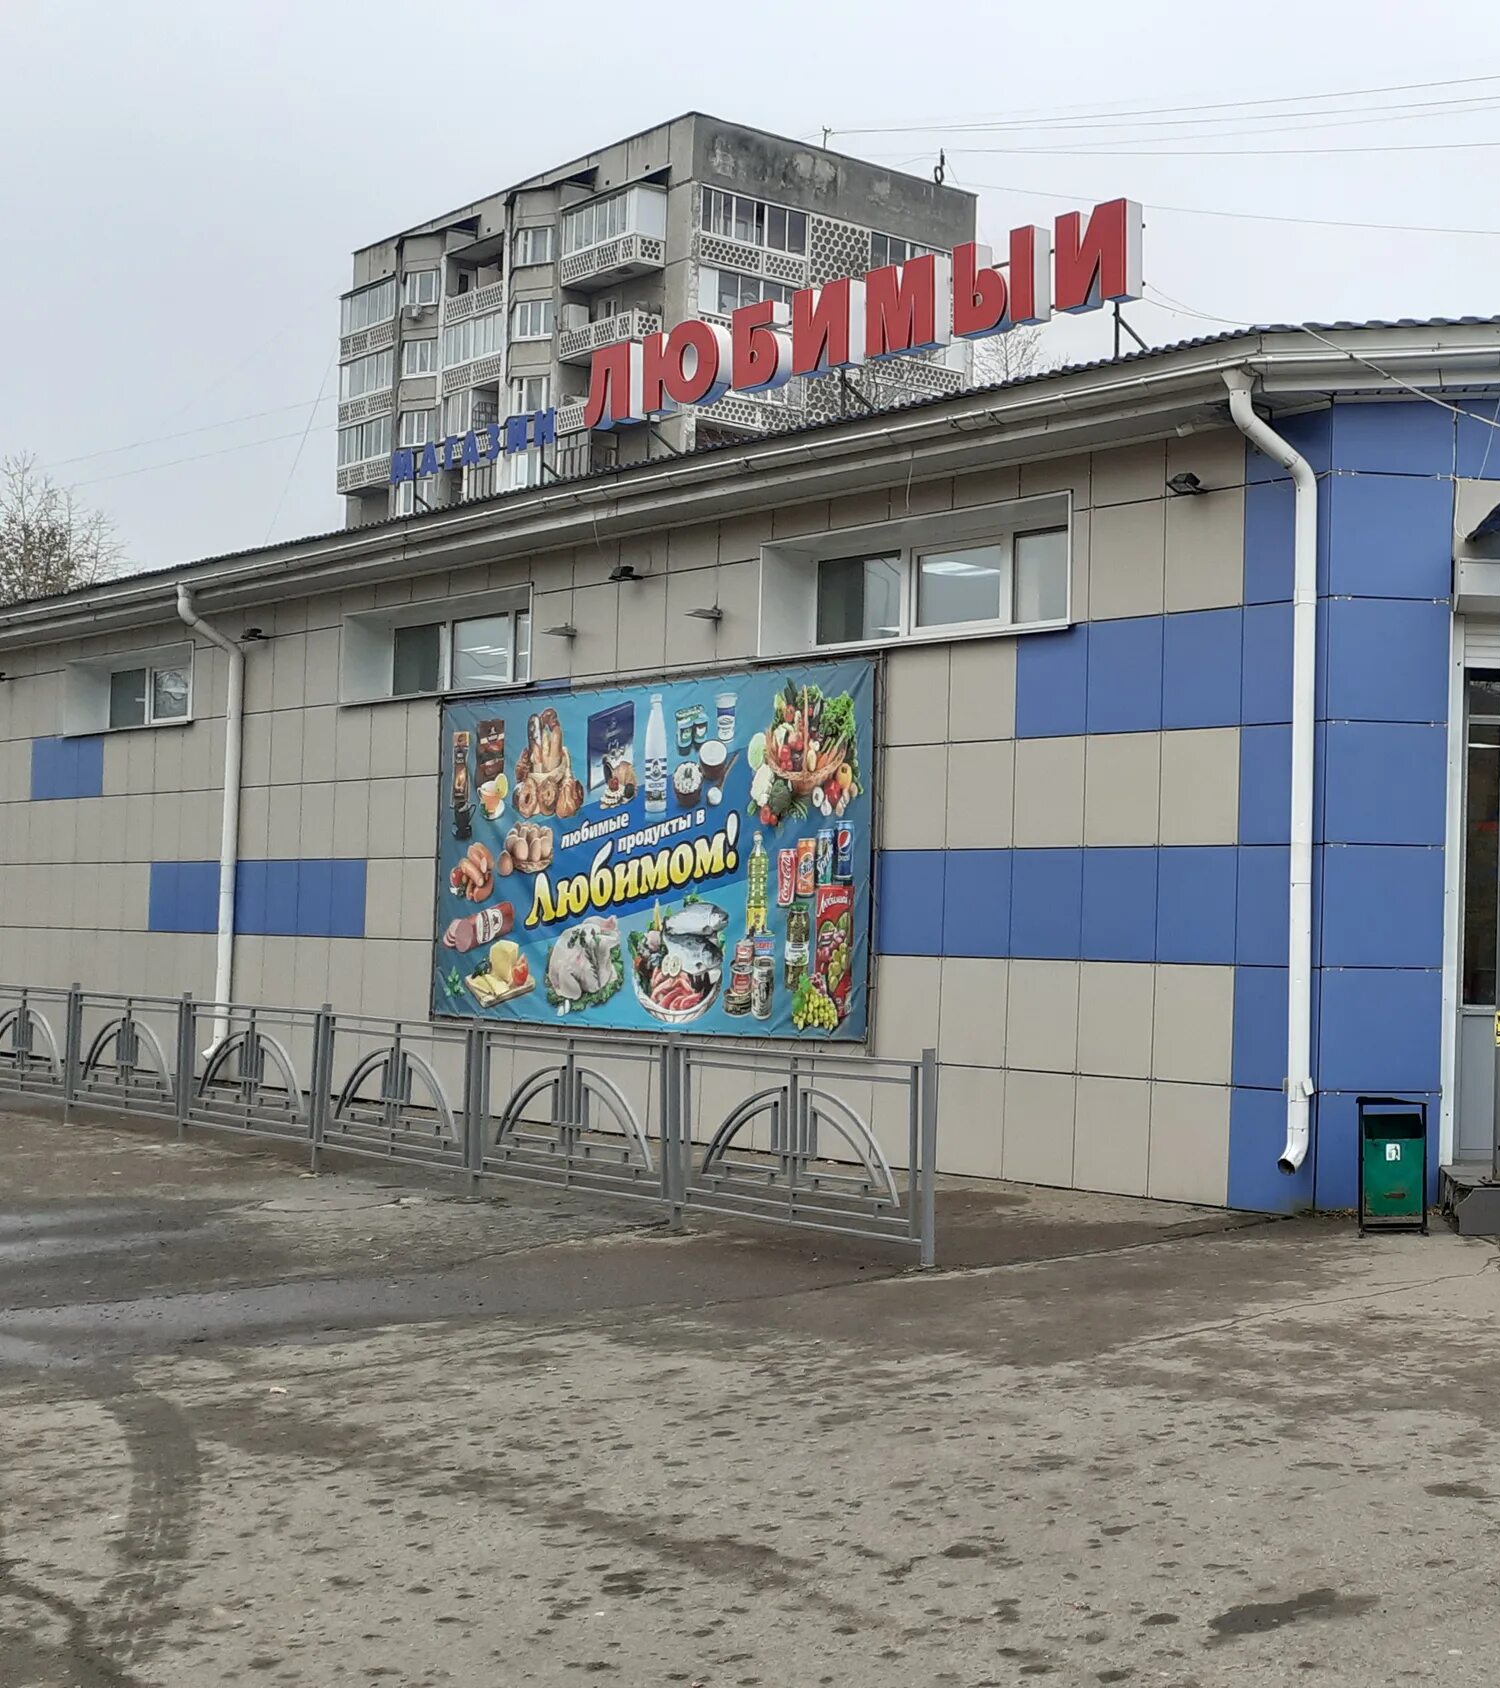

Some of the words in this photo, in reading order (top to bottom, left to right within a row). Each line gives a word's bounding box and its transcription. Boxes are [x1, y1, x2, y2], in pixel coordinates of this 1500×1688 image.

[389, 407, 554, 485] МАГАЗИН
[561, 812, 630, 849] любимые
[618, 814, 691, 854] продукты
[696, 809, 706, 824] в
[525, 812, 739, 926] Любимом!
